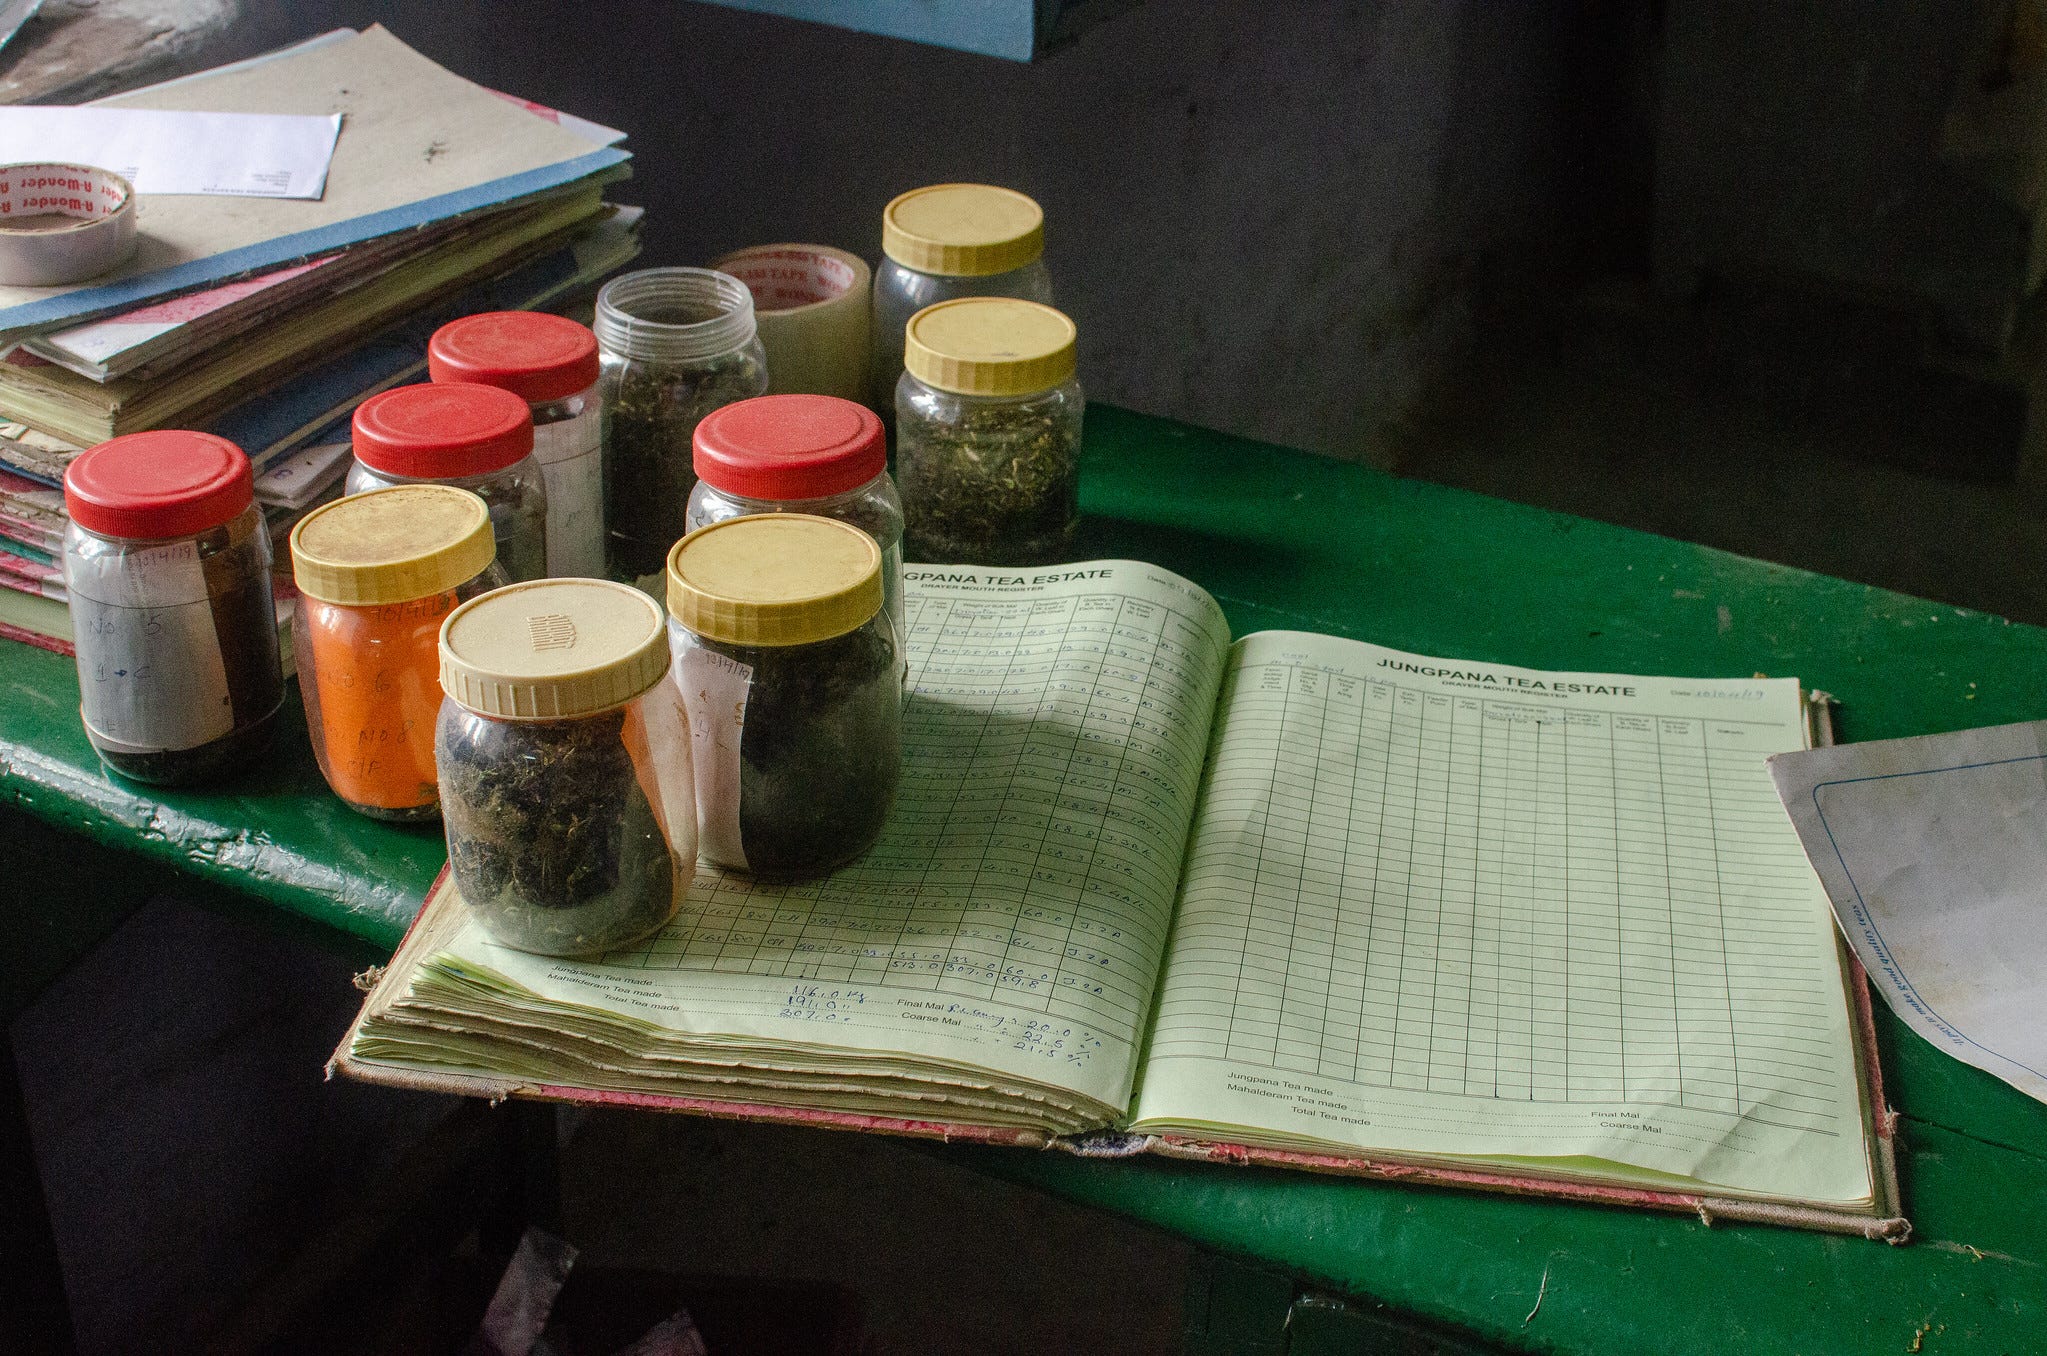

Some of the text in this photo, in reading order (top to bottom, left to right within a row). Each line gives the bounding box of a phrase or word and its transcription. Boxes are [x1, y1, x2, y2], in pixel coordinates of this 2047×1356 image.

[904, 568, 1114, 586] GPANA TEA ESTATE
[1376, 658, 1497, 684] JUNGPANA
[1503, 675, 1547, 691] TEA
[1553, 682, 1637, 698] ESTATE
[552, 965, 653, 986] Jungpana Tea made
[613, 986, 631, 994] Tea
[633, 989, 662, 998] made
[604, 993, 680, 1012] Total Tea made
[896, 998, 945, 1011] Final Mal
[901, 1012, 940, 1023] Coarse
[941, 1016, 962, 1027] Mal
[1227, 1071, 1334, 1096] Jungpana Tea made
[1226, 1083, 1348, 1111] Mahalderam Tea made
[1290, 1105, 1372, 1126] Total Tea made
[1600, 1121, 1662, 1134] Coarse Mal
